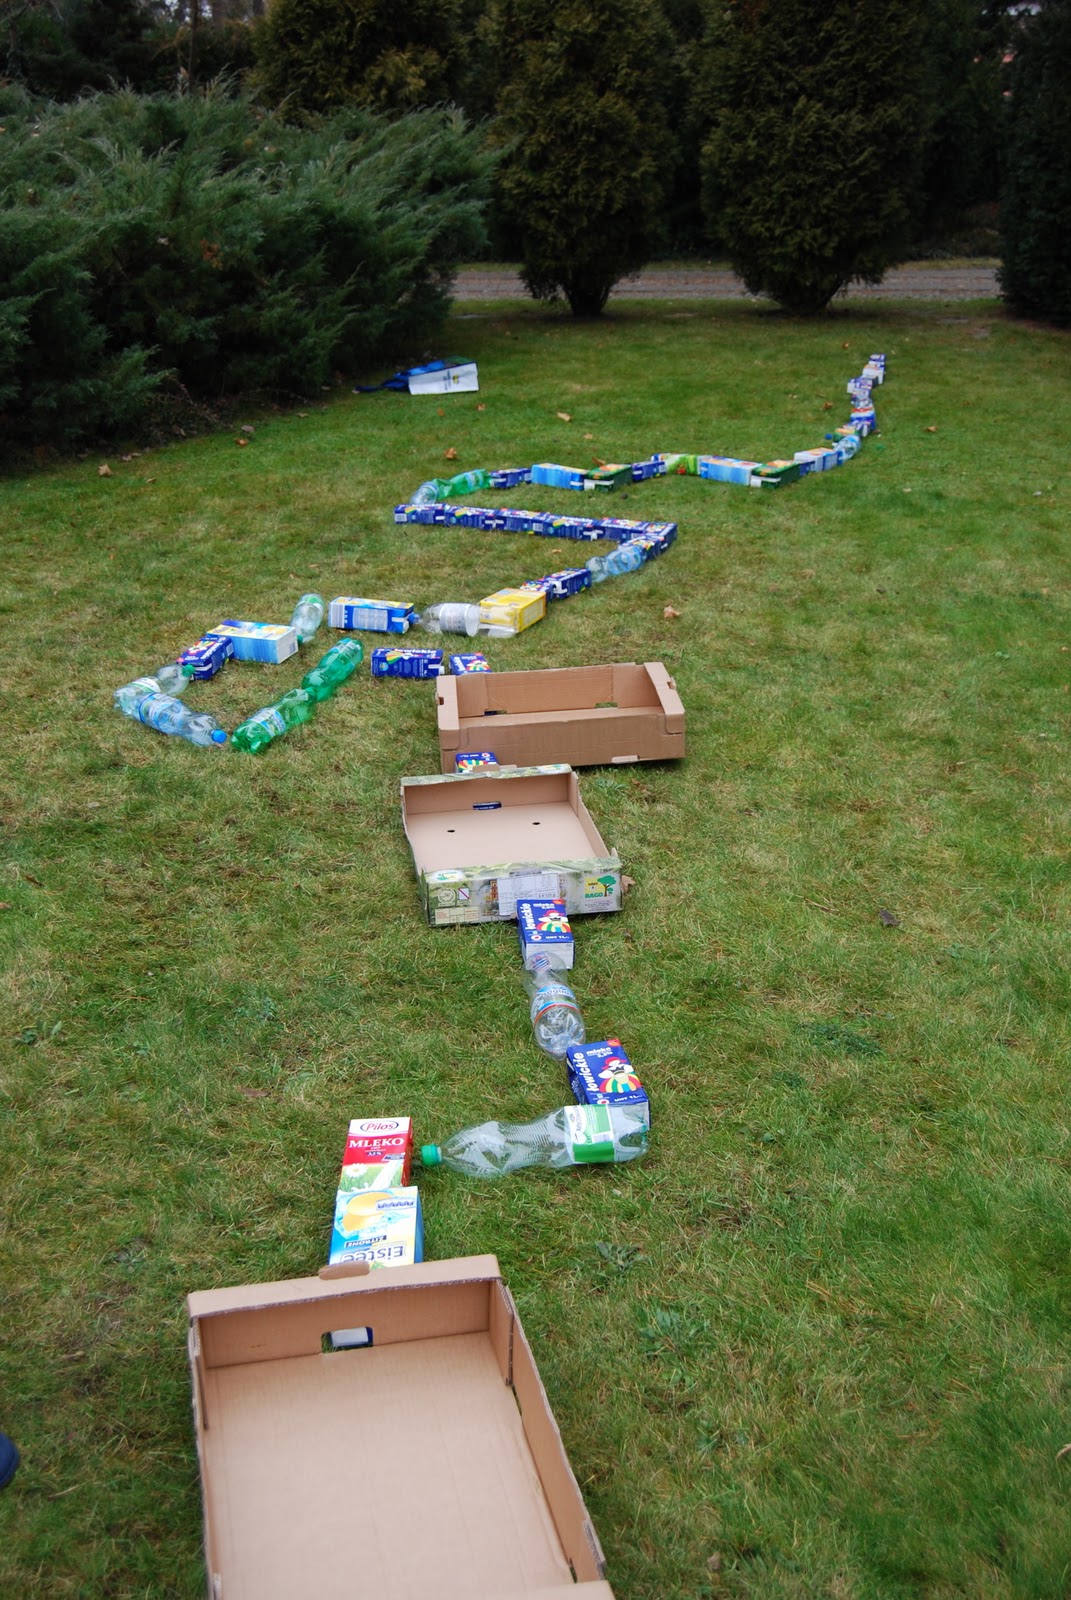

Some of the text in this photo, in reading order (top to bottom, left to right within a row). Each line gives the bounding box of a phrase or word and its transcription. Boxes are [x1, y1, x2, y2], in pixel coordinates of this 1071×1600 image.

[586, 1047, 611, 1056] mleko
[366, 1122, 394, 1131] Pilos
[349, 1137, 405, 1148] MLEKO
[347, 1236, 383, 1247] ZITRONE
[343, 1246, 404, 1262] Eistee
